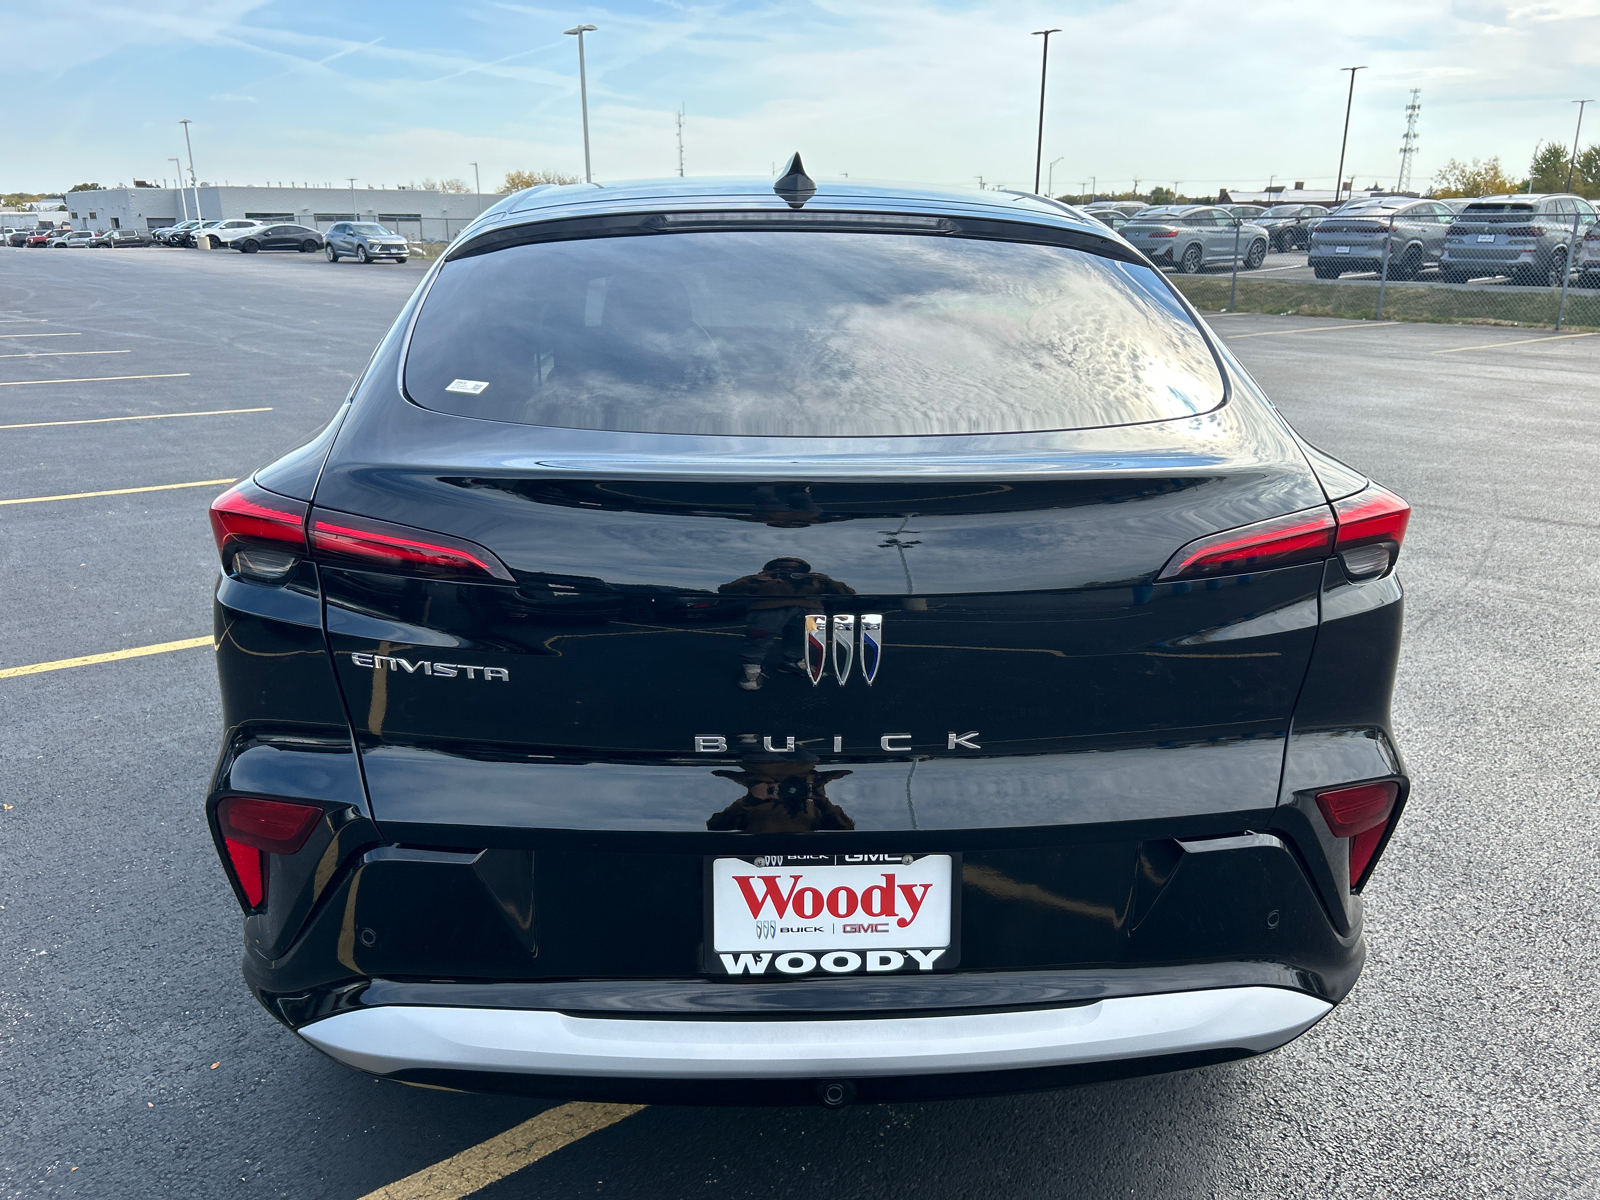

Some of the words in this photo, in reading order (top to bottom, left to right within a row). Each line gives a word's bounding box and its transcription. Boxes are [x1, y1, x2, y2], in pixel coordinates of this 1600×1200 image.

[351, 652, 510, 682] ENVISTA
[694, 731, 981, 753] BUICK
[732, 873, 933, 928] Woody
[842, 922, 890, 934] GMC
[719, 949, 947, 975] WOODY
